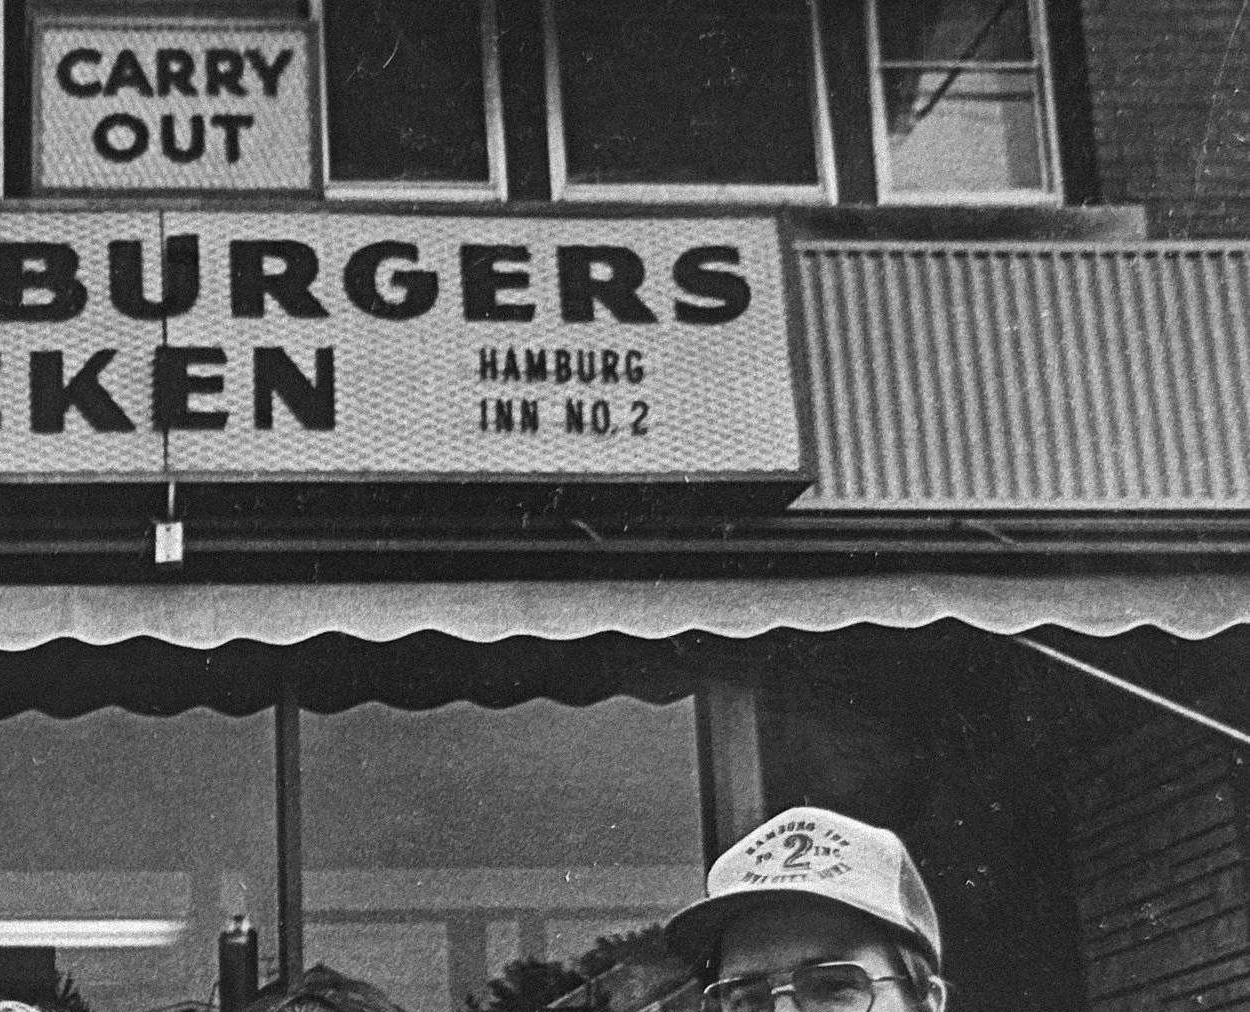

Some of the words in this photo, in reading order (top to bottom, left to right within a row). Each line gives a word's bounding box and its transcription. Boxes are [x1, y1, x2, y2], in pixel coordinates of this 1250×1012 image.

[56, 47, 294, 98] CARRY
[92, 112, 254, 164] OUT
[478, 347, 644, 385] HAMBURG
[480, 398, 539, 434] INN
[782, 833, 814, 871] 2
